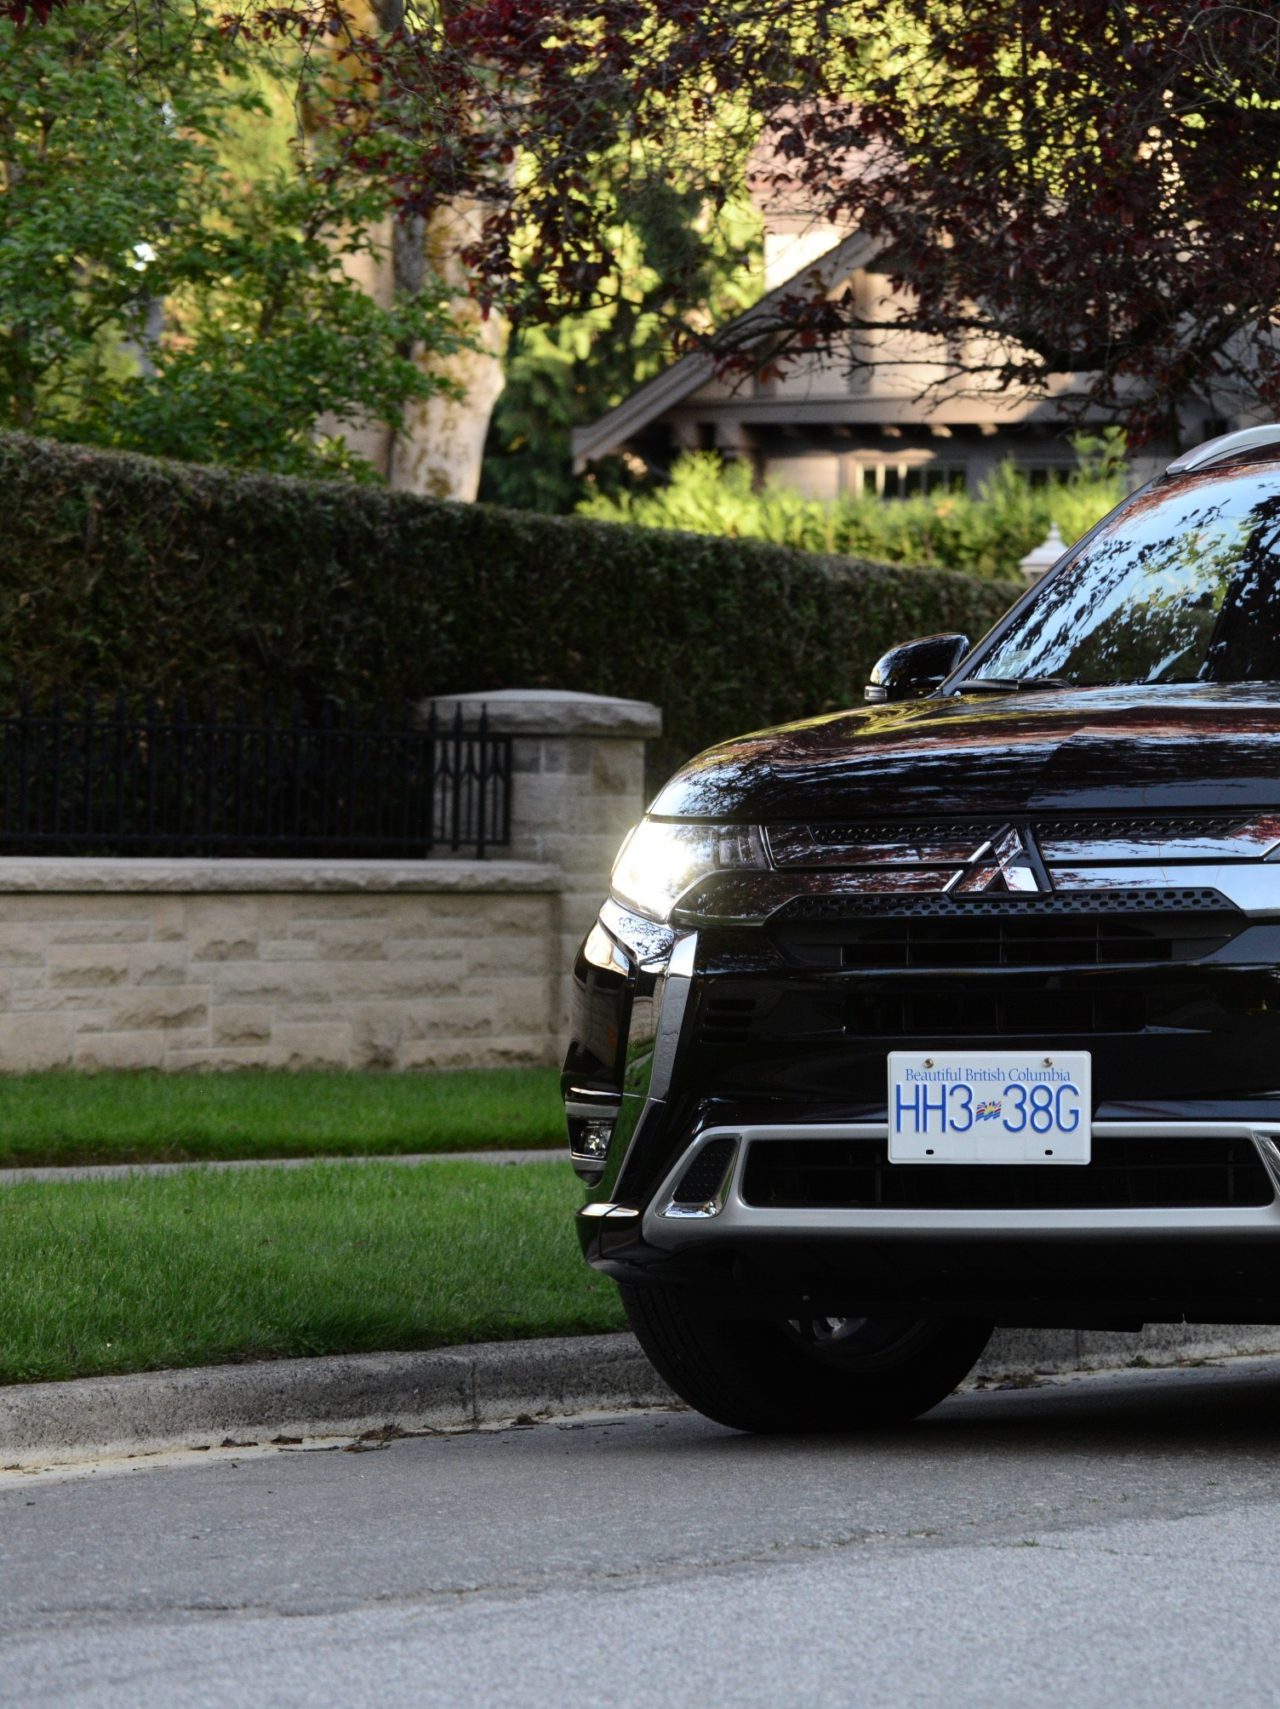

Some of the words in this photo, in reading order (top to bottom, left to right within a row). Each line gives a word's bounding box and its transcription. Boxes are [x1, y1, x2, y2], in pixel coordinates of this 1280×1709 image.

[905, 1068, 962, 1081] Beautiful
[965, 1068, 1005, 1081] British
[1008, 1068, 1071, 1081] Columbia
[896, 1084, 973, 1133] HH3
[1002, 1084, 1080, 1133] 38G
